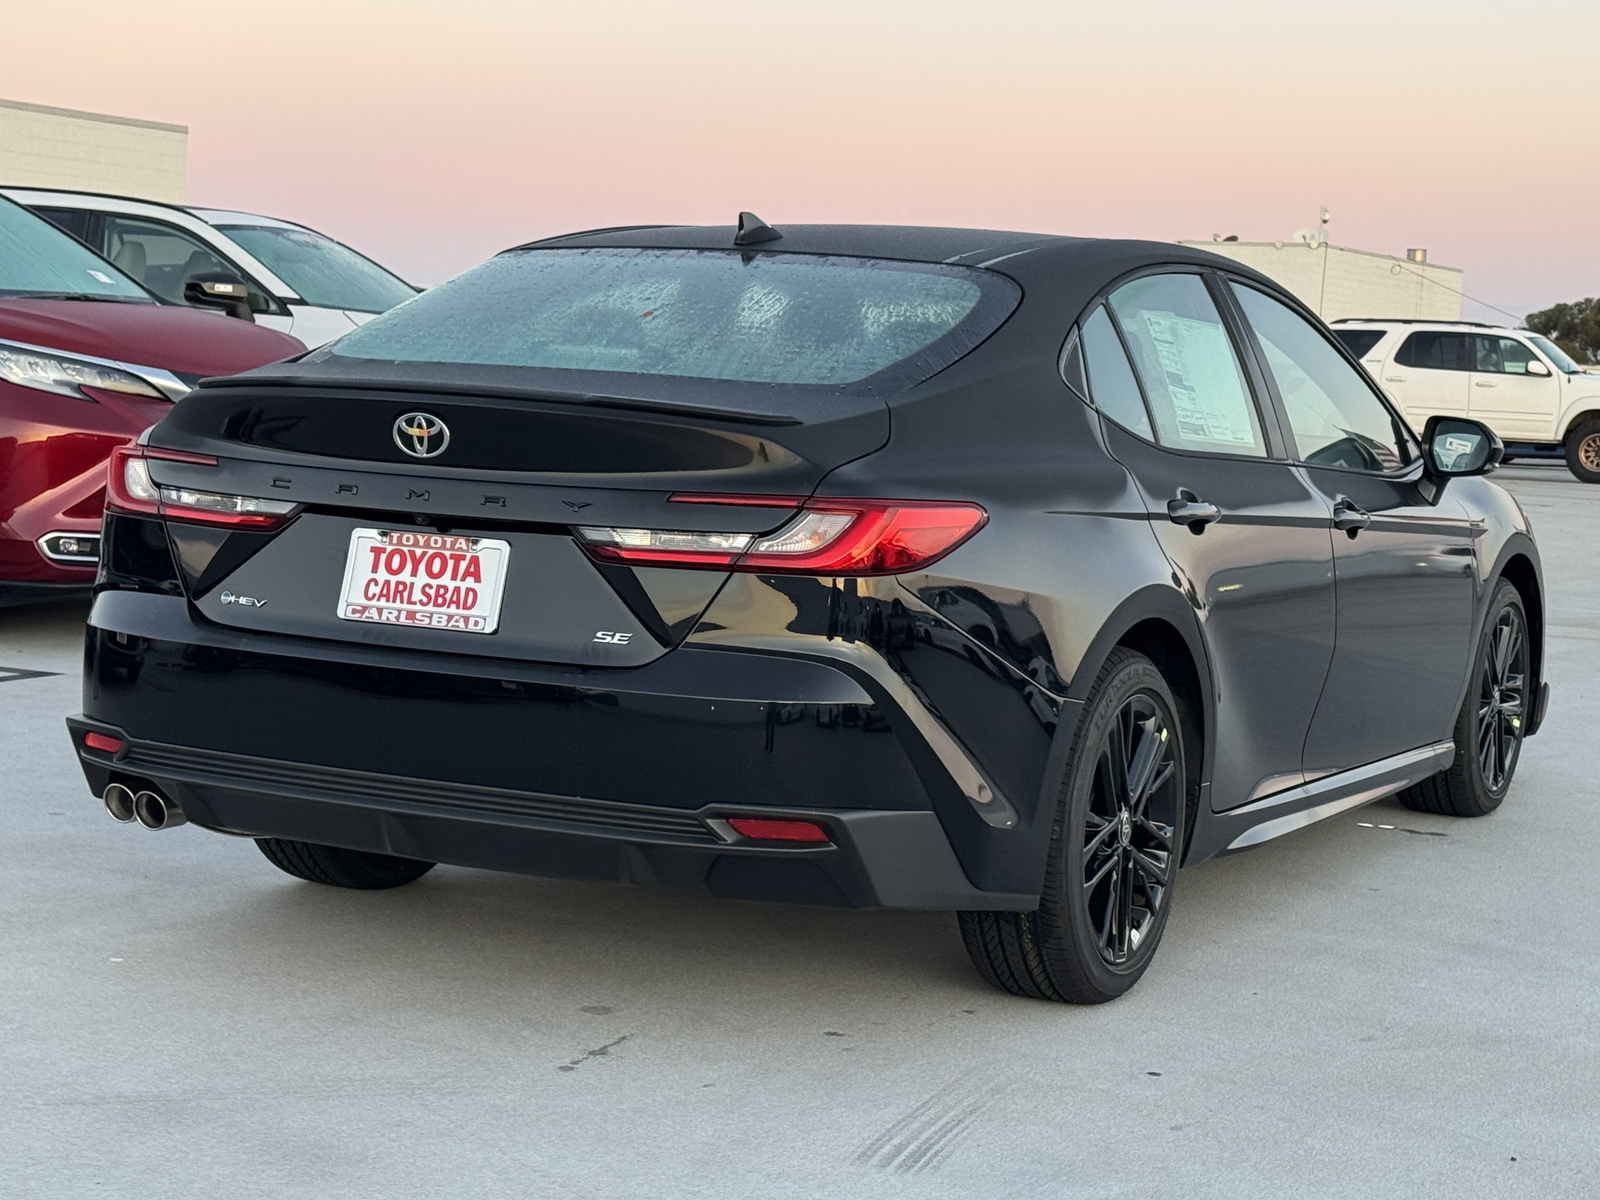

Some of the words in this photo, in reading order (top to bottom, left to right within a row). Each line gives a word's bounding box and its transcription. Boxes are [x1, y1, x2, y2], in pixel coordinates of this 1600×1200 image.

[270, 475, 594, 514] CAMRY
[390, 532, 470, 551] TOYOTA
[369, 546, 482, 583] TOYOTA
[363, 577, 478, 611] CARLSBAD
[345, 605, 486, 631] CARLSBAD
[592, 630, 634, 645] SE
